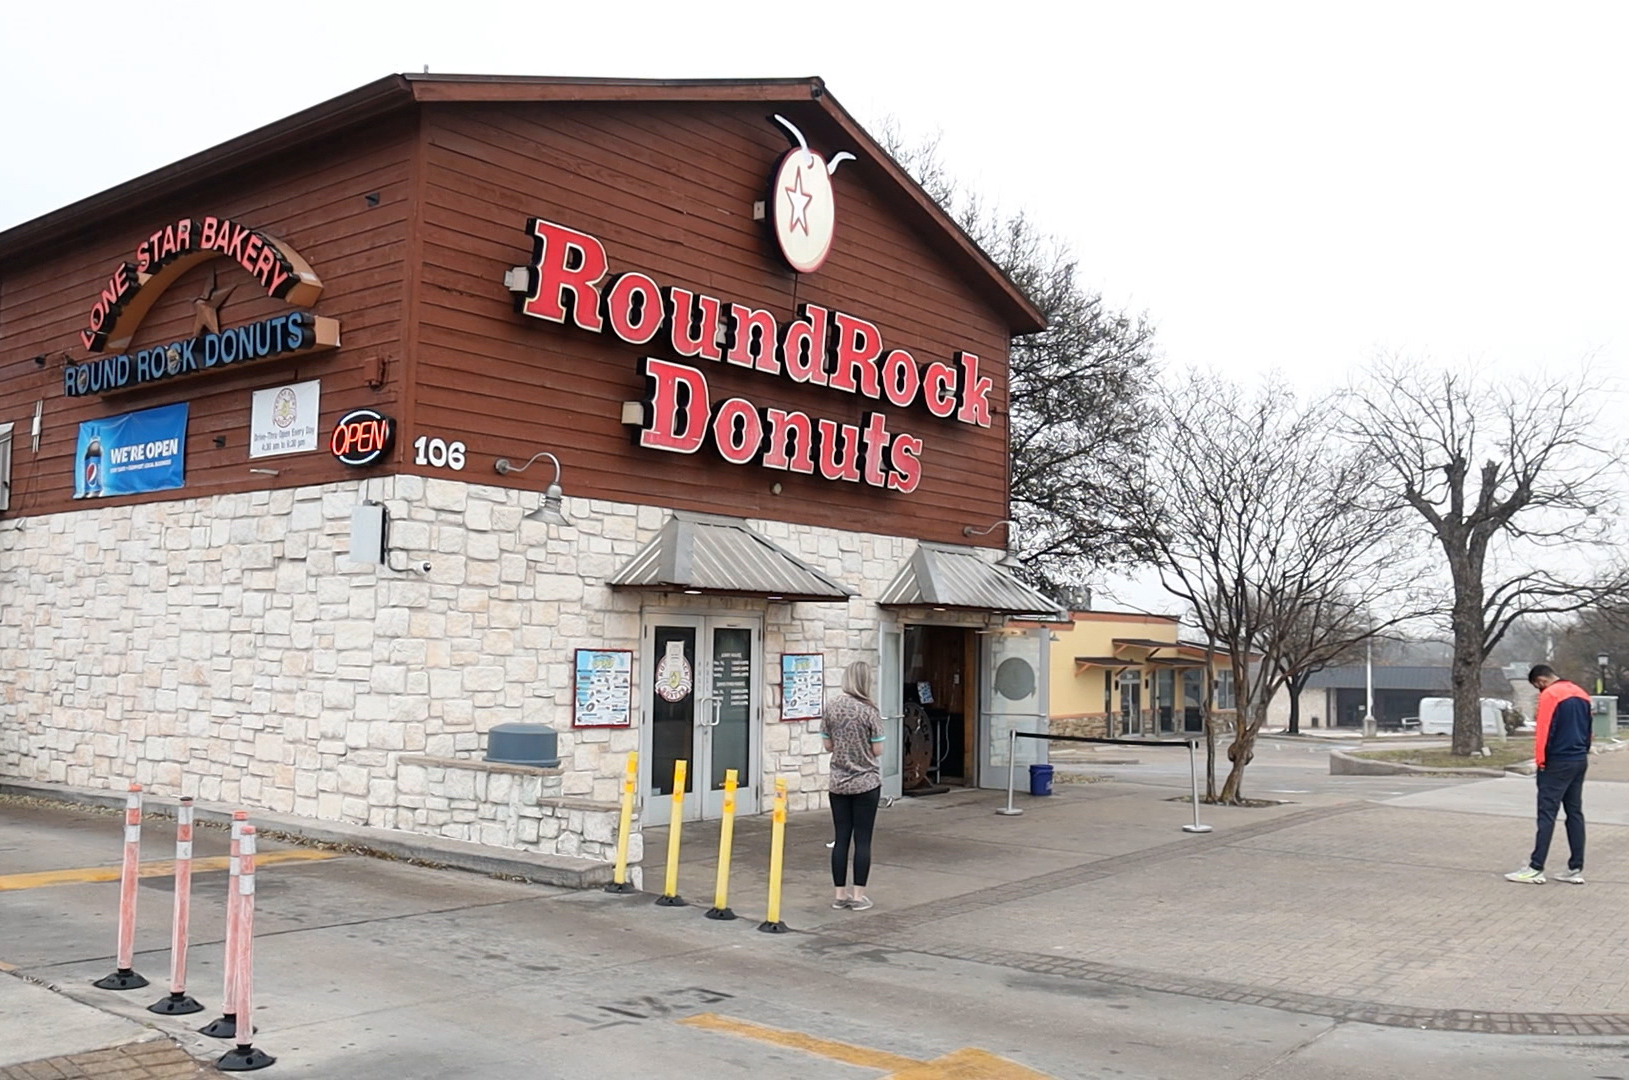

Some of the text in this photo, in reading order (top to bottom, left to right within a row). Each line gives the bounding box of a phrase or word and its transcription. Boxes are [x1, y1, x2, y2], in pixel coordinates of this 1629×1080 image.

[80, 216, 289, 350] LONE STAR BAKERY
[64, 355, 131, 396] ROUND
[204, 312, 303, 367] DONUTS
[110, 438, 178, 464] WE'RE OPEN
[331, 420, 387, 456] OPEN
[414, 436, 466, 470] 106
[639, 357, 924, 493] Donuts
